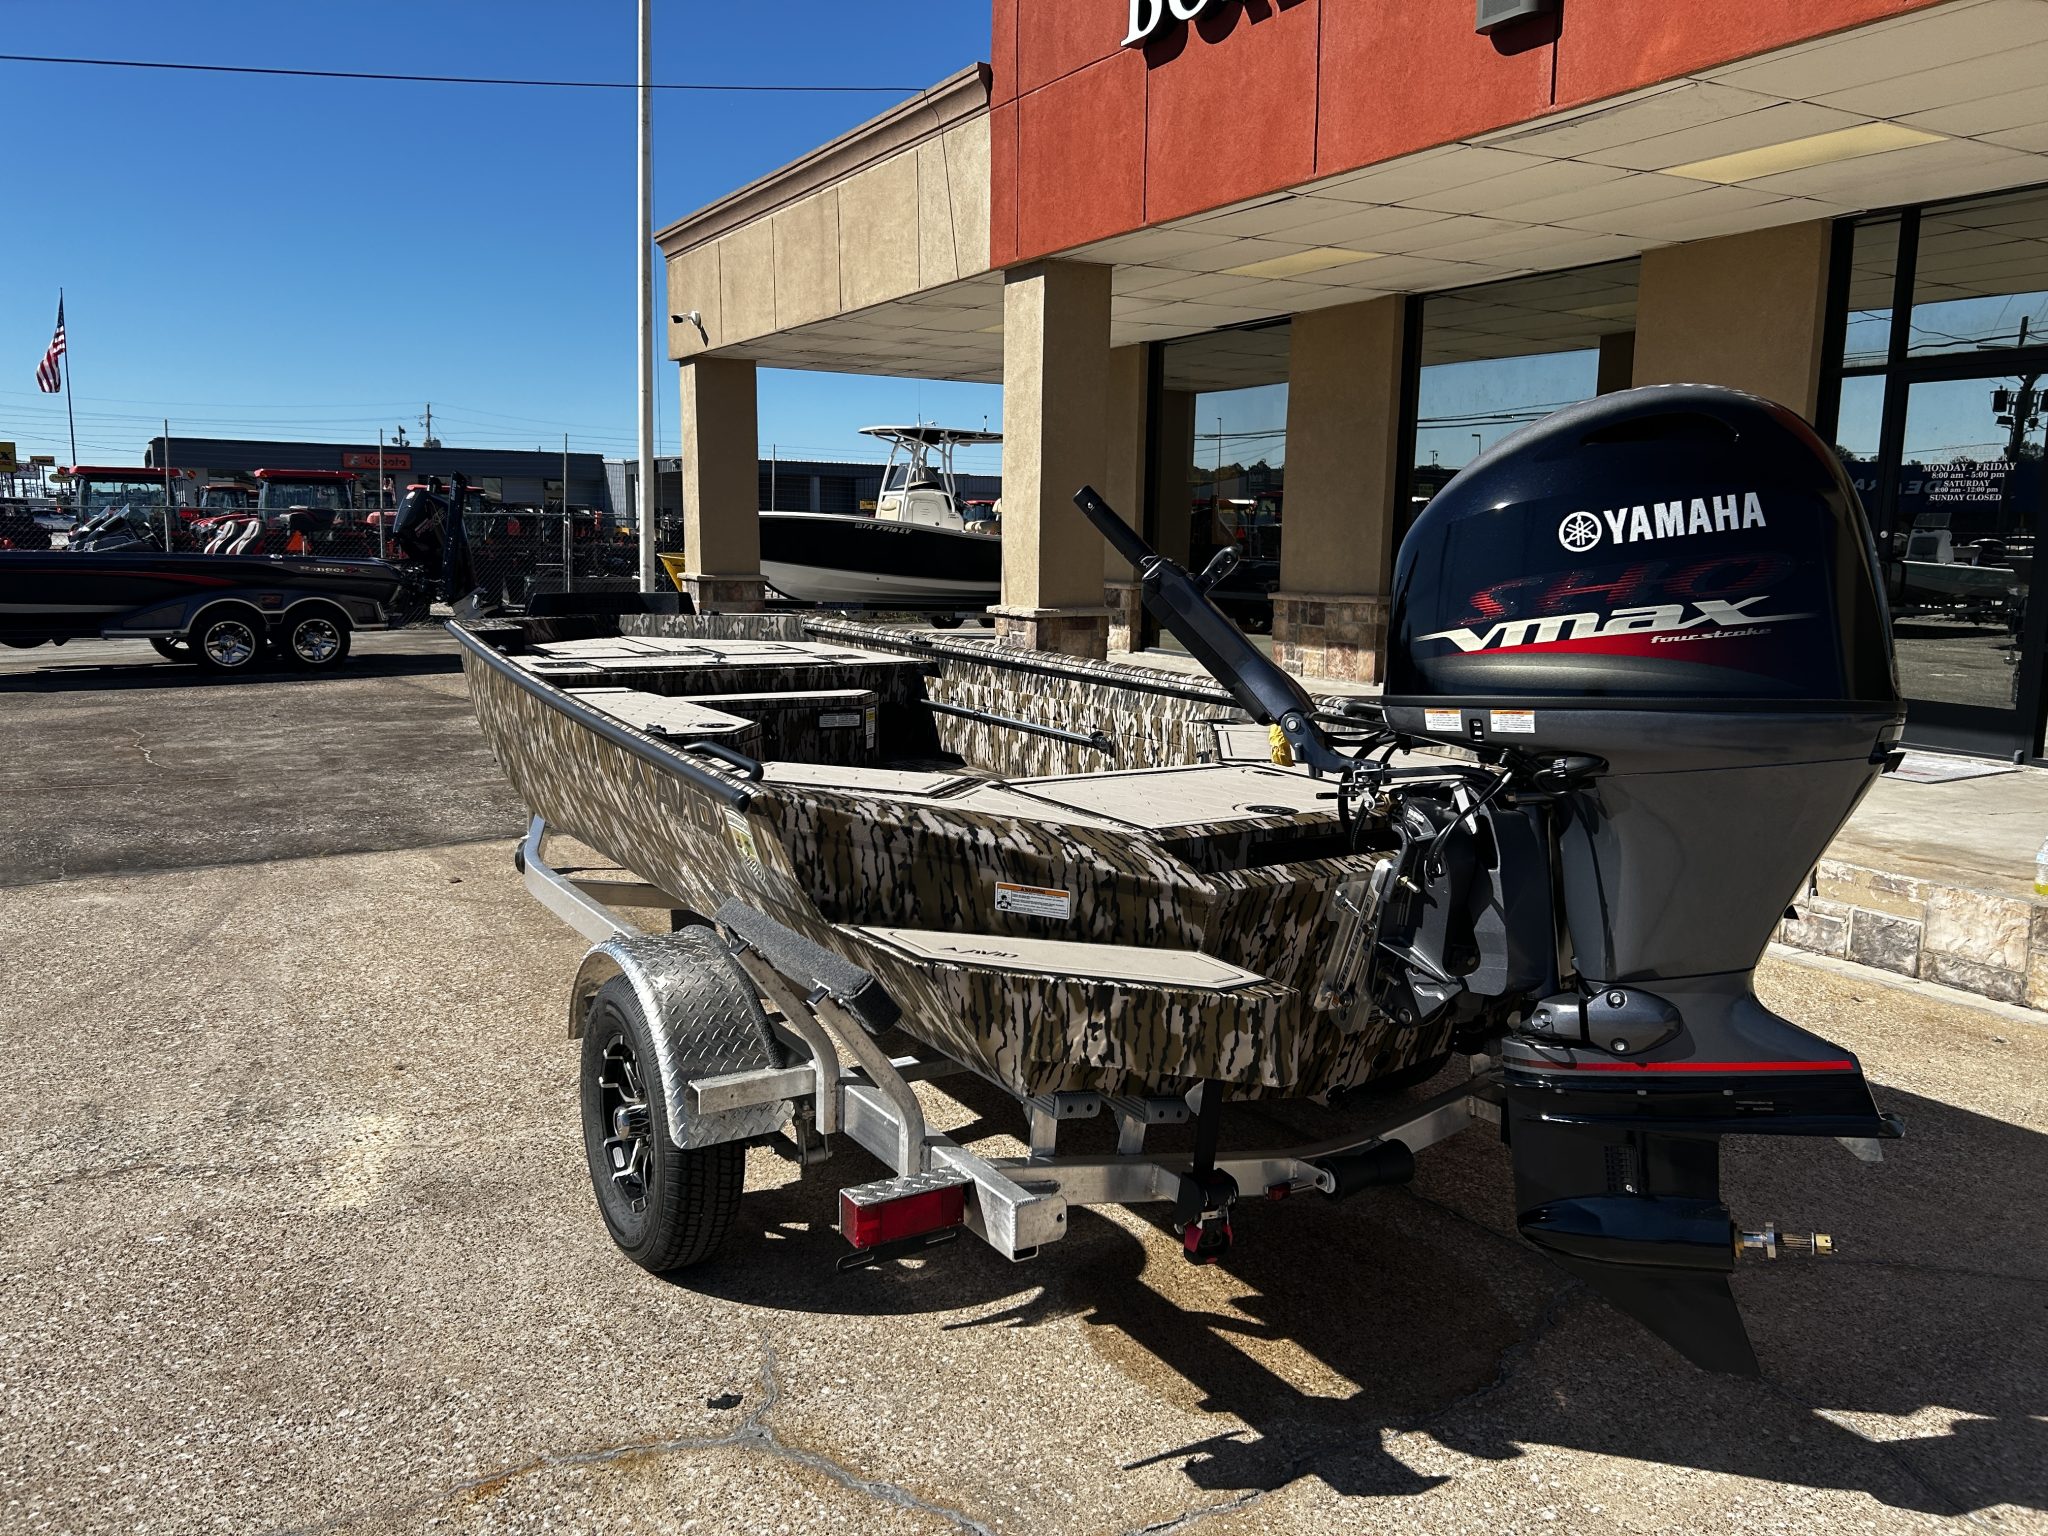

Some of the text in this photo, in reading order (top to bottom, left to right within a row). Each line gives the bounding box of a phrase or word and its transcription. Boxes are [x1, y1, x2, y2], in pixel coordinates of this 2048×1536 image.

[1922, 464, 1968, 472] MONDAY
[1976, 462, 2017, 471] FRIDAY
[1931, 471, 1949, 479] 8:00
[1971, 471, 1989, 479] 5:00
[1990, 472, 2005, 480] pm
[1943, 479, 1990, 487] SATURDAY
[1929, 493, 2002, 501] SUNDAY CLOSED
[1603, 492, 1767, 544] YAMAHA
